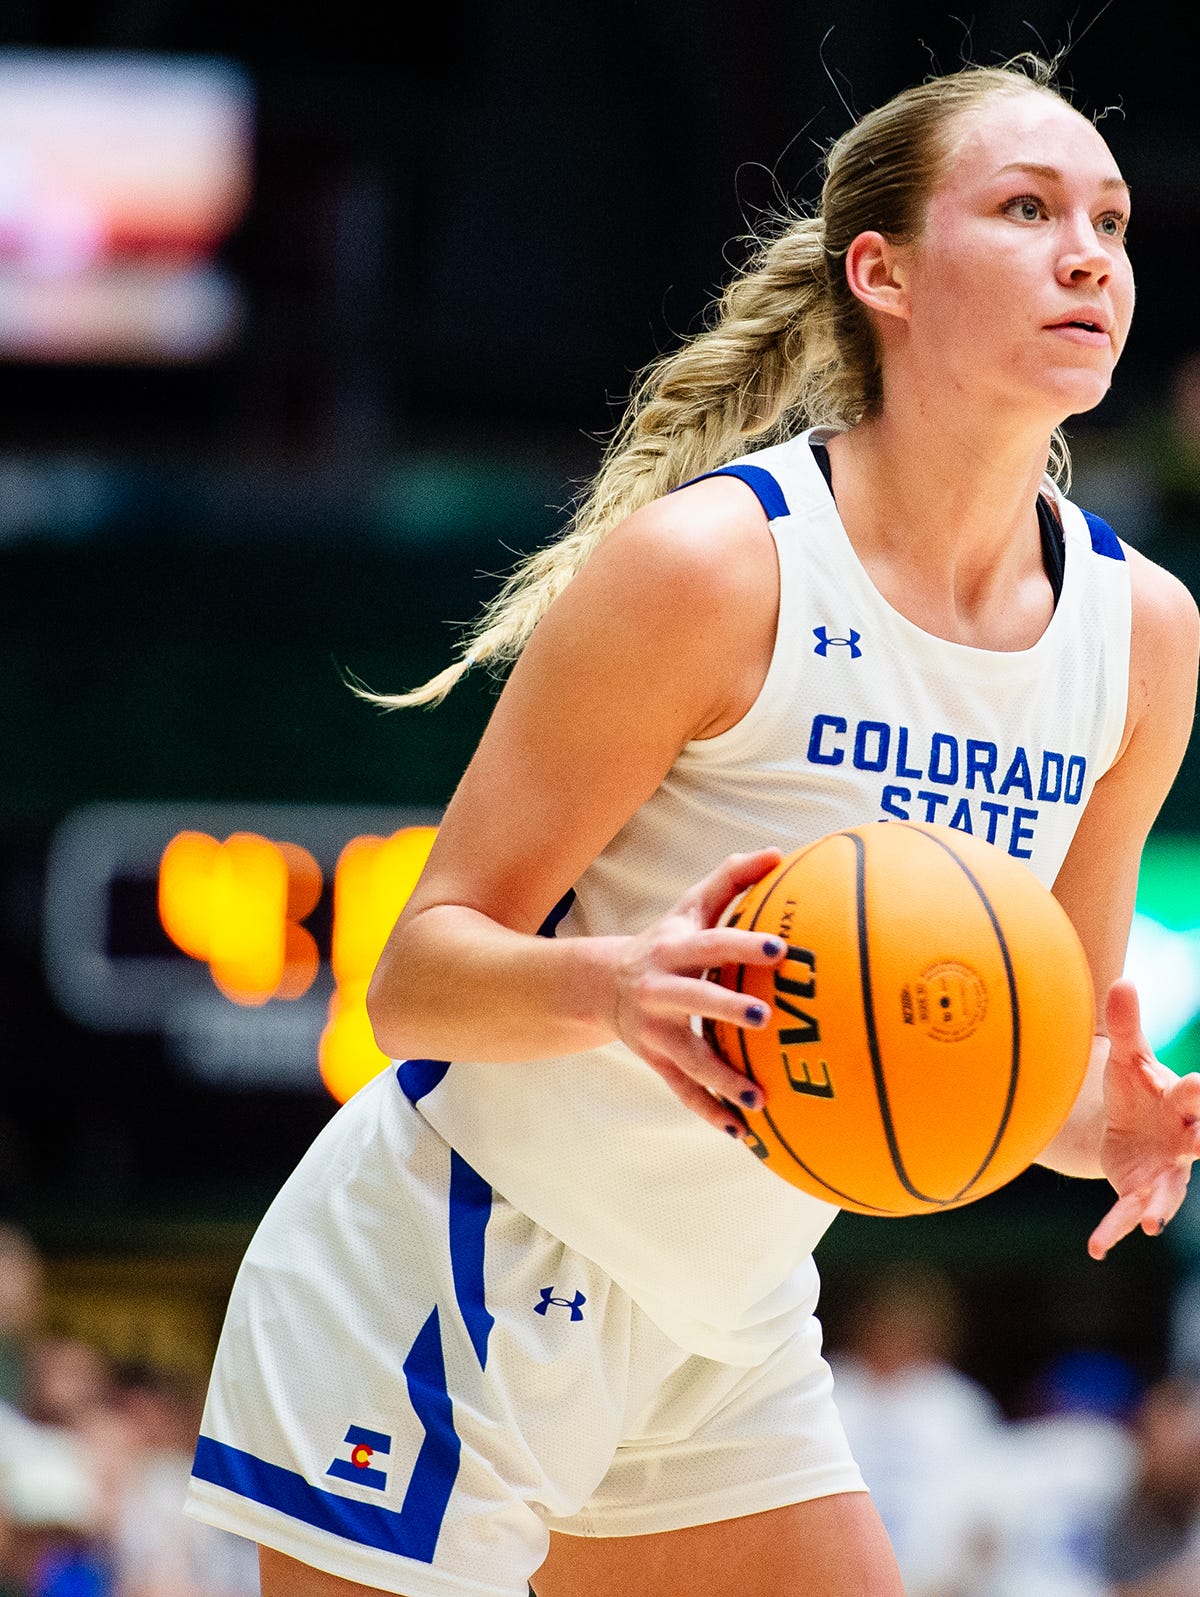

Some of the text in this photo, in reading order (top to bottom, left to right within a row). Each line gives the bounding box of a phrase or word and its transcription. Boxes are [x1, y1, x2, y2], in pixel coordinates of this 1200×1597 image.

[807, 714, 1087, 805] COLORADO
[878, 785, 1039, 859] STATE
[774, 945, 834, 1098] EVO
